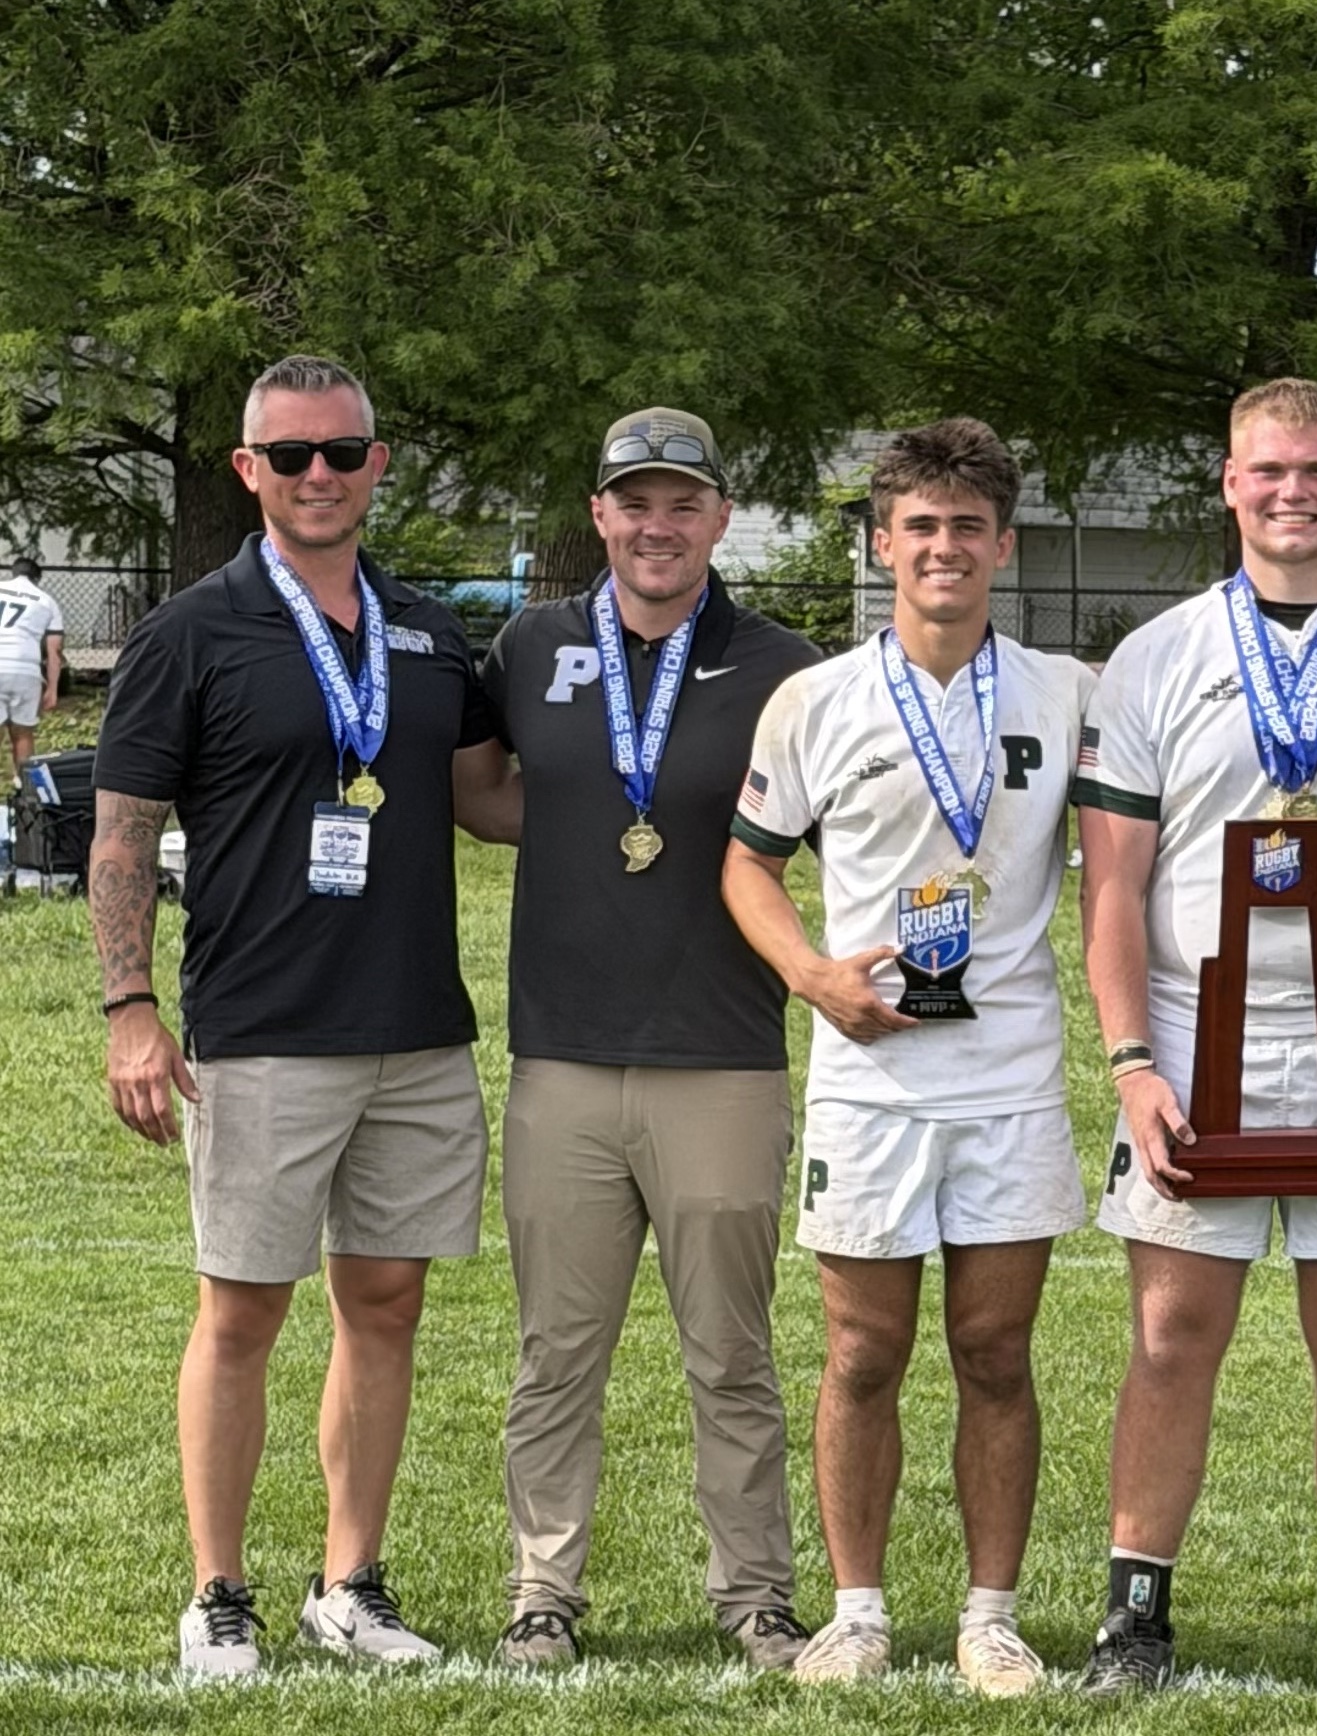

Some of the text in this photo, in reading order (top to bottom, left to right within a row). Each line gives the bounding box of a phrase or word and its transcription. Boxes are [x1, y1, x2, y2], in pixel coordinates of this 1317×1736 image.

[594, 593, 622, 674] CHAMPION
[1229, 585, 1263, 658] CHAMPION
[290, 594, 329, 647] SPRING
[315, 644, 361, 724] CHAMPION
[368, 634, 385, 689] SPRING
[545, 645, 600, 703] P
[648, 672, 678, 729] SPRING
[664, 621, 691, 671] CHAM
[1246, 654, 1278, 709] SPRING
[607, 674, 631, 732] SPRING
[1263, 703, 1296, 746] 2024
[895, 681, 931, 738] SPRING
[916, 735, 964, 818] CHAMPION
[999, 735, 1043, 790] P
[1254, 843, 1301, 870] RUGBY
[900, 898, 968, 936] RUGBY
[900, 921, 968, 947] INDIANA
[919, 1001, 948, 1013] MVP
[804, 1157, 829, 1213] P
[1106, 1141, 1132, 1196] P
